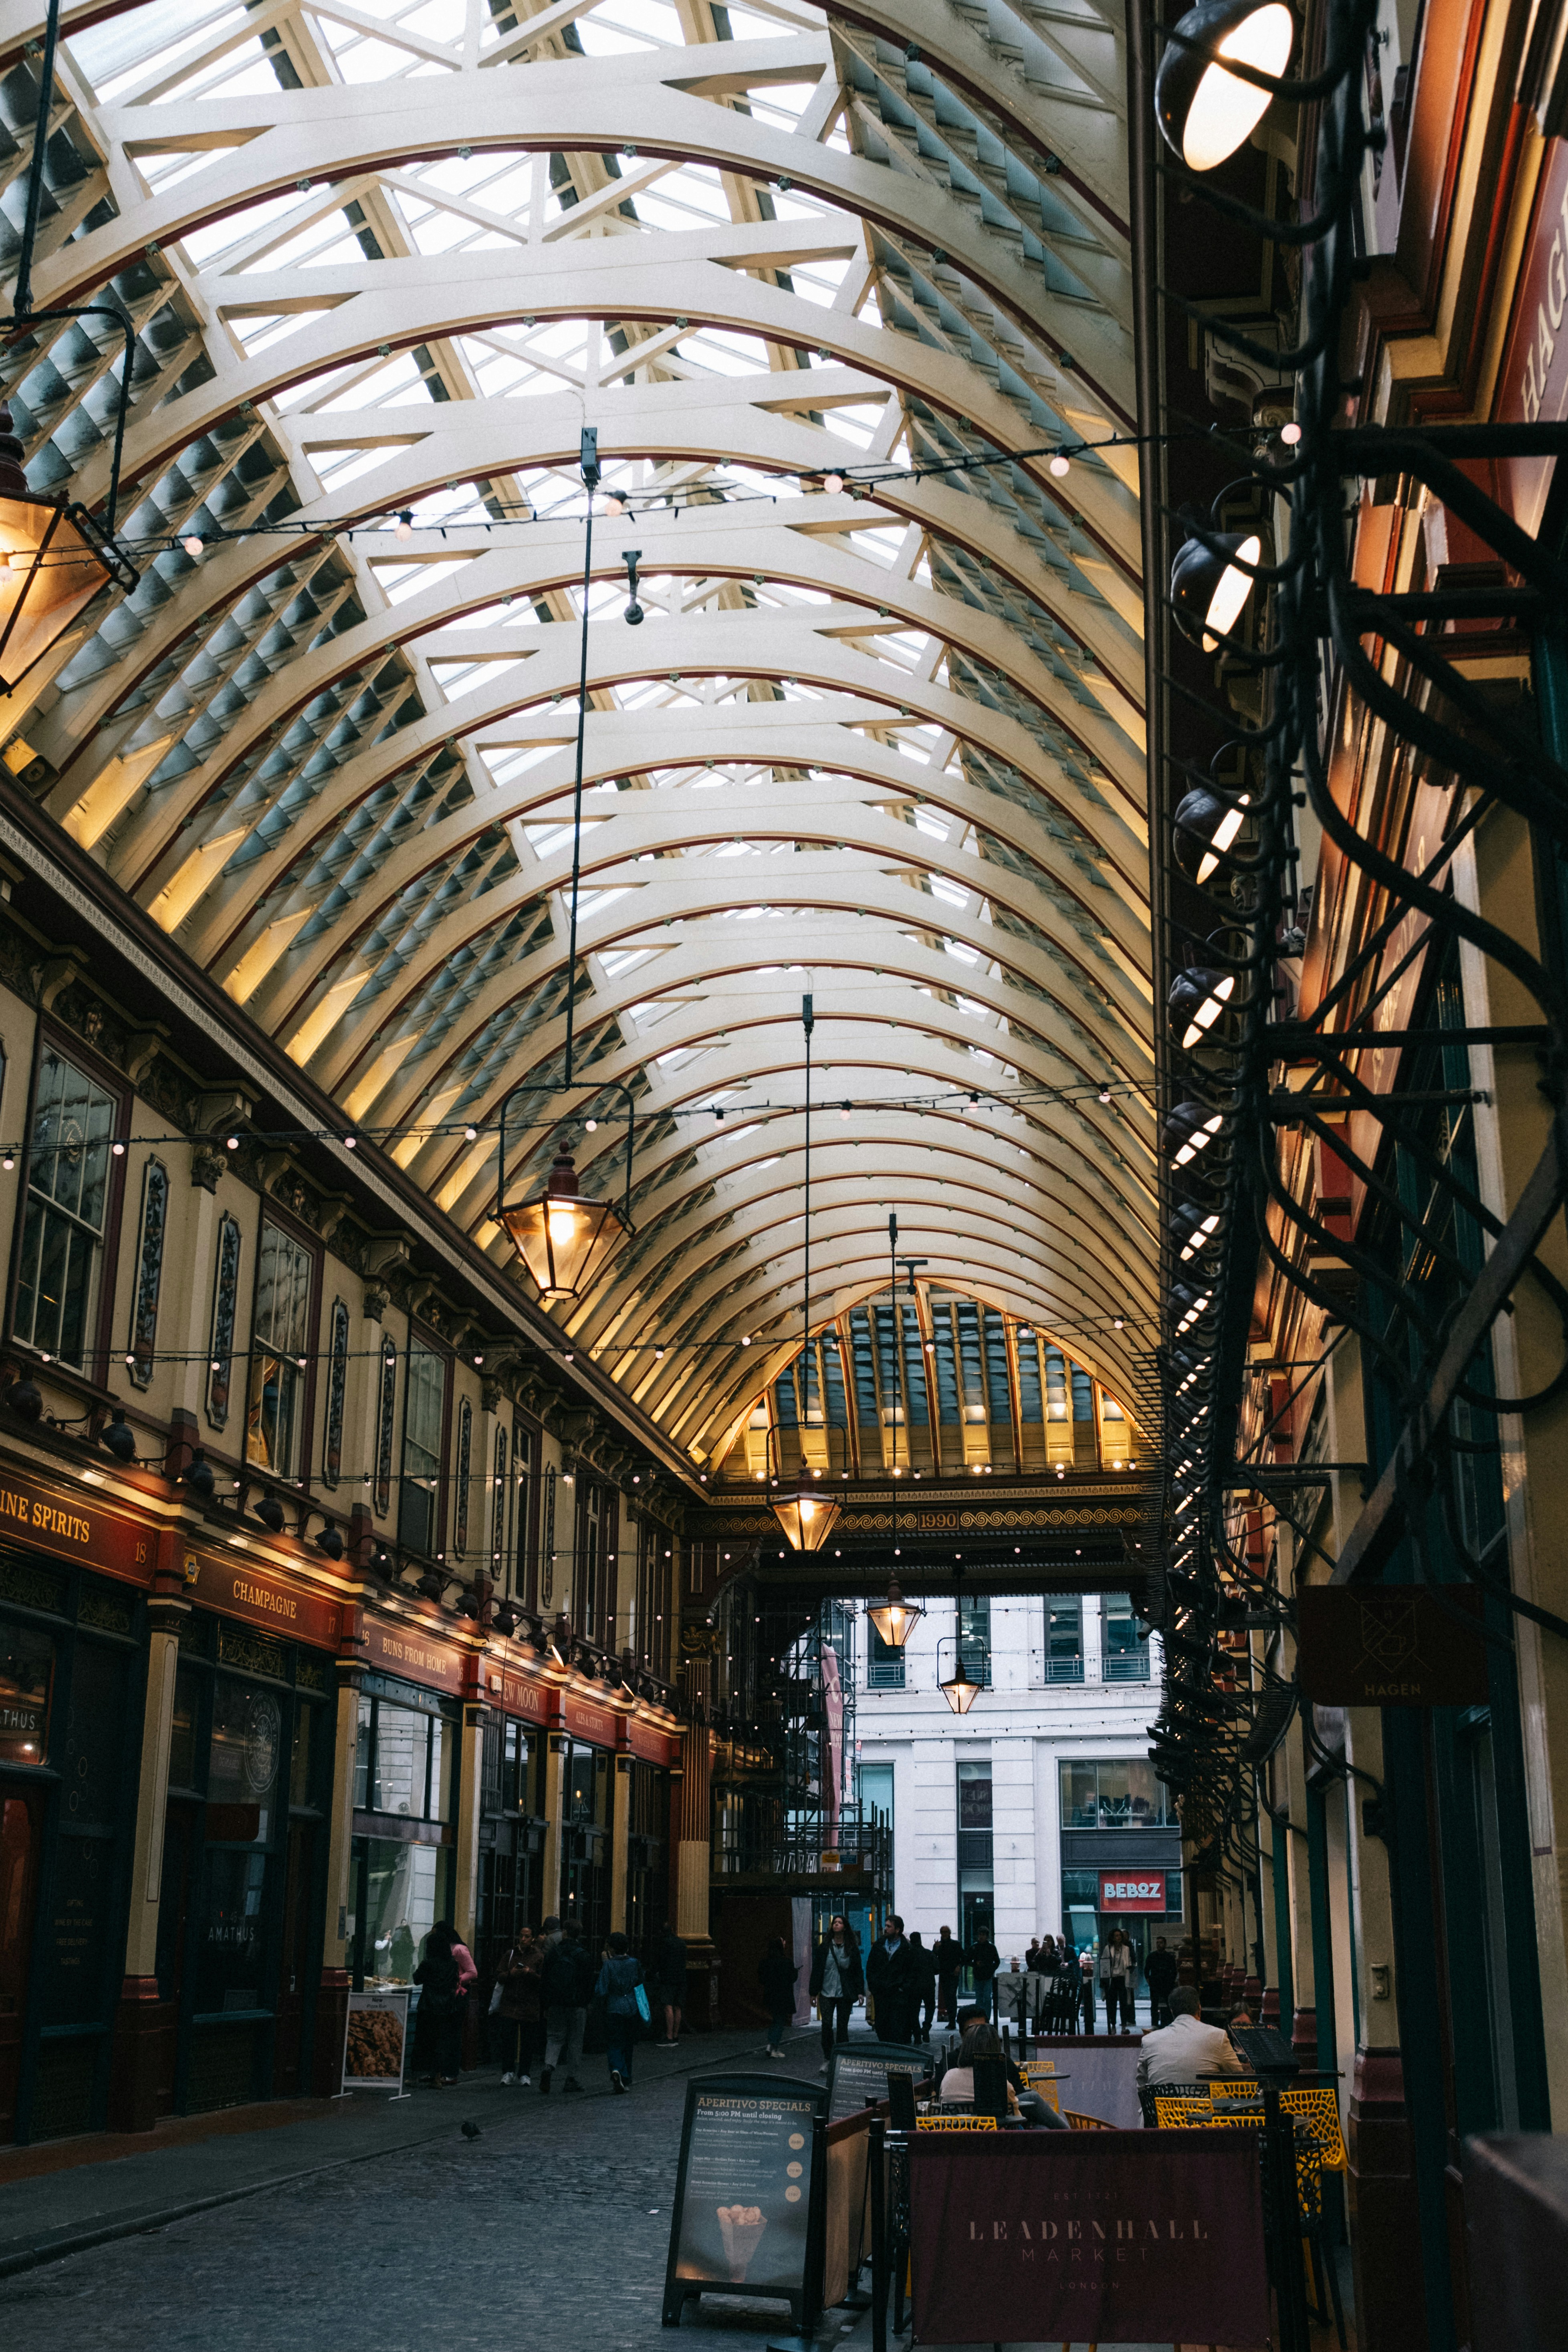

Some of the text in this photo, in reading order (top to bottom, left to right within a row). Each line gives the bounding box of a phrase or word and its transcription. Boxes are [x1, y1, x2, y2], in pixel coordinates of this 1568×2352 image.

[32, 1502, 90, 1543] SPIRITS
[921, 1513, 956, 1527] 1990
[135, 1541, 147, 1564] 18
[233, 1579, 297, 1619] CHAMPAGNE
[328, 1616, 336, 1634] 17
[362, 1630, 369, 1646] 16
[382, 1637, 446, 1675] BUNS FROM HOME
[457, 1666, 464, 1681] 16
[498, 1679, 539, 1712] EW MOON
[1364, 1683, 1421, 1696] HAGEN
[575, 1711, 603, 1732] ALES & STOUTS
[1104, 1882, 1161, 1898] BEBOZ
[208, 1926, 255, 1941] AMATHUS
[840, 2058, 922, 2074] APERITIVO SPECIALS
[698, 2097, 811, 2112] APERITIVO SPECIALS
[759, 2112, 782, 2120] closing
[1053, 2192, 1118, 2201] EST 1321
[969, 2219, 1208, 2240] LEADENHALL
[1021, 2248, 1148, 2262] MARKET
[1059, 2281, 1119, 2290] LONDON
